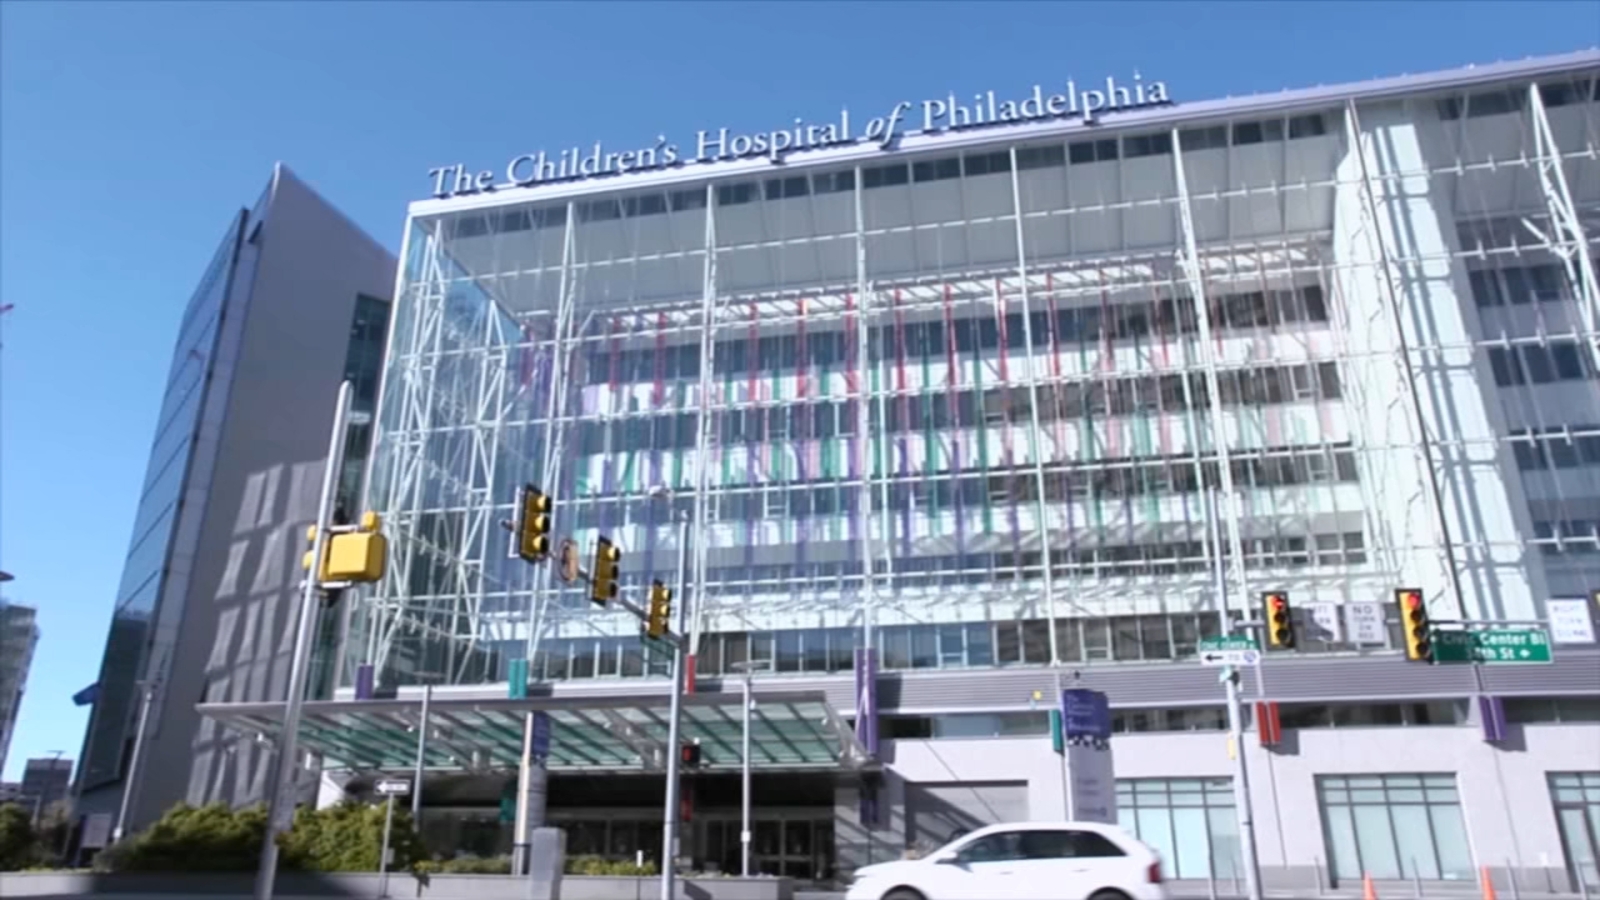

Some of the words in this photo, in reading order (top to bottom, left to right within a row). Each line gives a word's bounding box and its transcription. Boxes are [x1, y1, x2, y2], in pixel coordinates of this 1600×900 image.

[429, 164, 494, 196] The
[506, 134, 678, 186] Children's
[696, 106, 849, 164] Hospital
[864, 101, 912, 150] of
[922, 72, 1170, 133] Philadelphia
[1352, 605, 1374, 615] NO
[1442, 633, 1477, 645] Civic
[1479, 633, 1527, 646] Center
[1500, 647, 1515, 660] St
